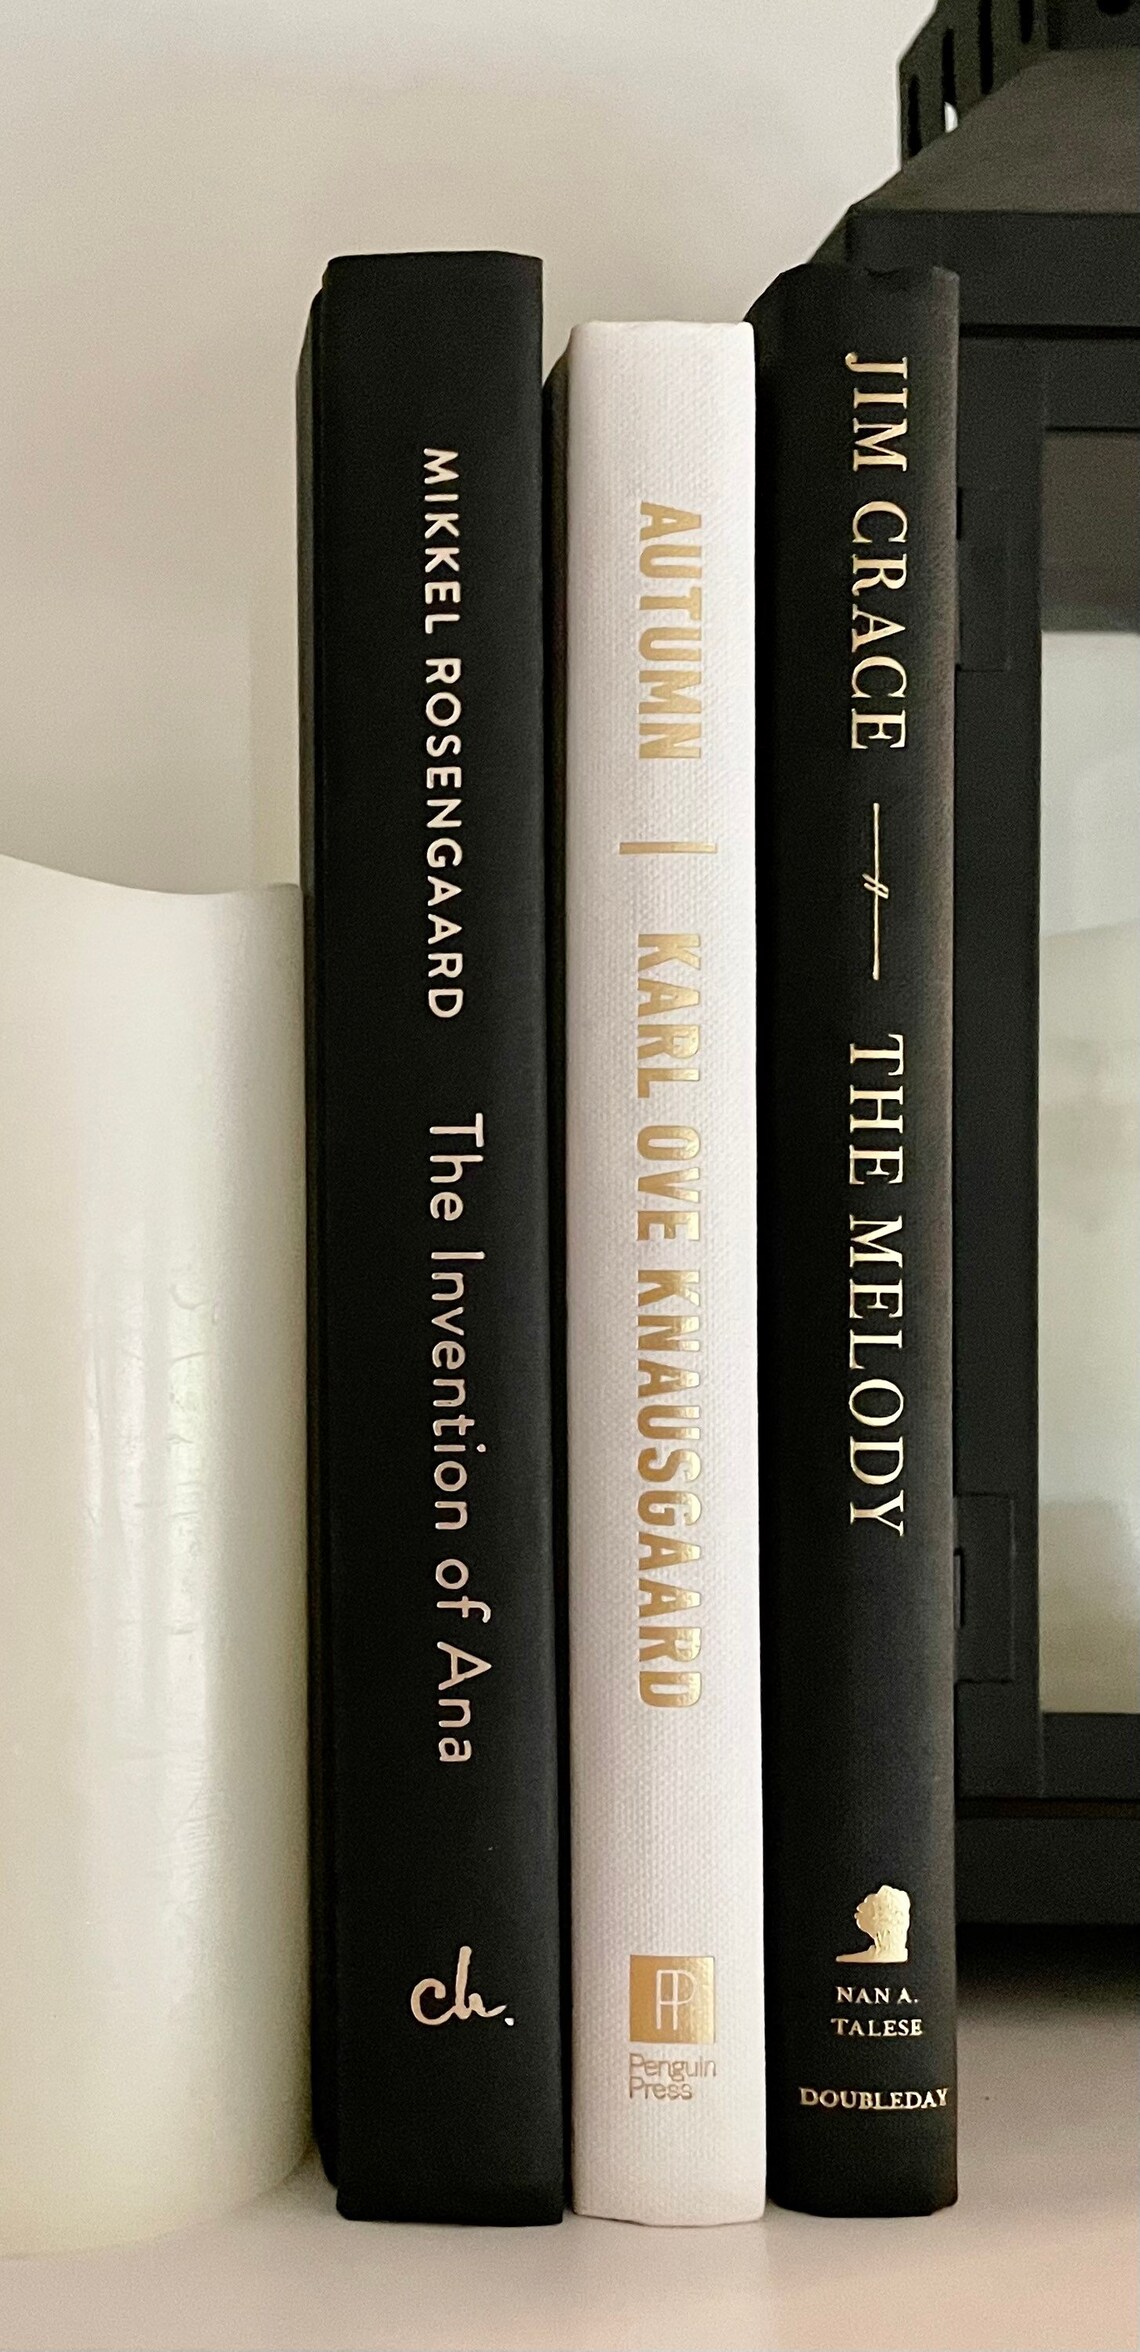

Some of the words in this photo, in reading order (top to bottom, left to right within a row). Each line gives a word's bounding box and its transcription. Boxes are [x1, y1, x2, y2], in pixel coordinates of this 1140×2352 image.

[845, 353, 907, 471] JIM
[424, 449, 460, 633] MIKKEL
[638, 502, 702, 759] AUTUMN
[852, 502, 907, 749] CRACE
[426, 659, 463, 1017] ROSENGAARD
[637, 933, 700, 1098] KARL
[430, 1113, 484, 1220] The
[850, 1034, 903, 1184] THE
[637, 1125, 701, 1241] OVE
[431, 1252, 486, 1529] Invention
[849, 1215, 903, 1536] MELODY
[637, 1269, 703, 1708] KNAUSGAARD
[436, 1559, 491, 1623] of
[437, 1642, 491, 1761] Ana
[831, 2019, 922, 2036] TALESE
[836, 1986, 890, 2004] NAN
[897, 1987, 919, 2004] A.
[629, 2053, 717, 2082] Penguin
[629, 2076, 693, 2100] Press
[799, 2087, 948, 2110] DOUBLEDAY
